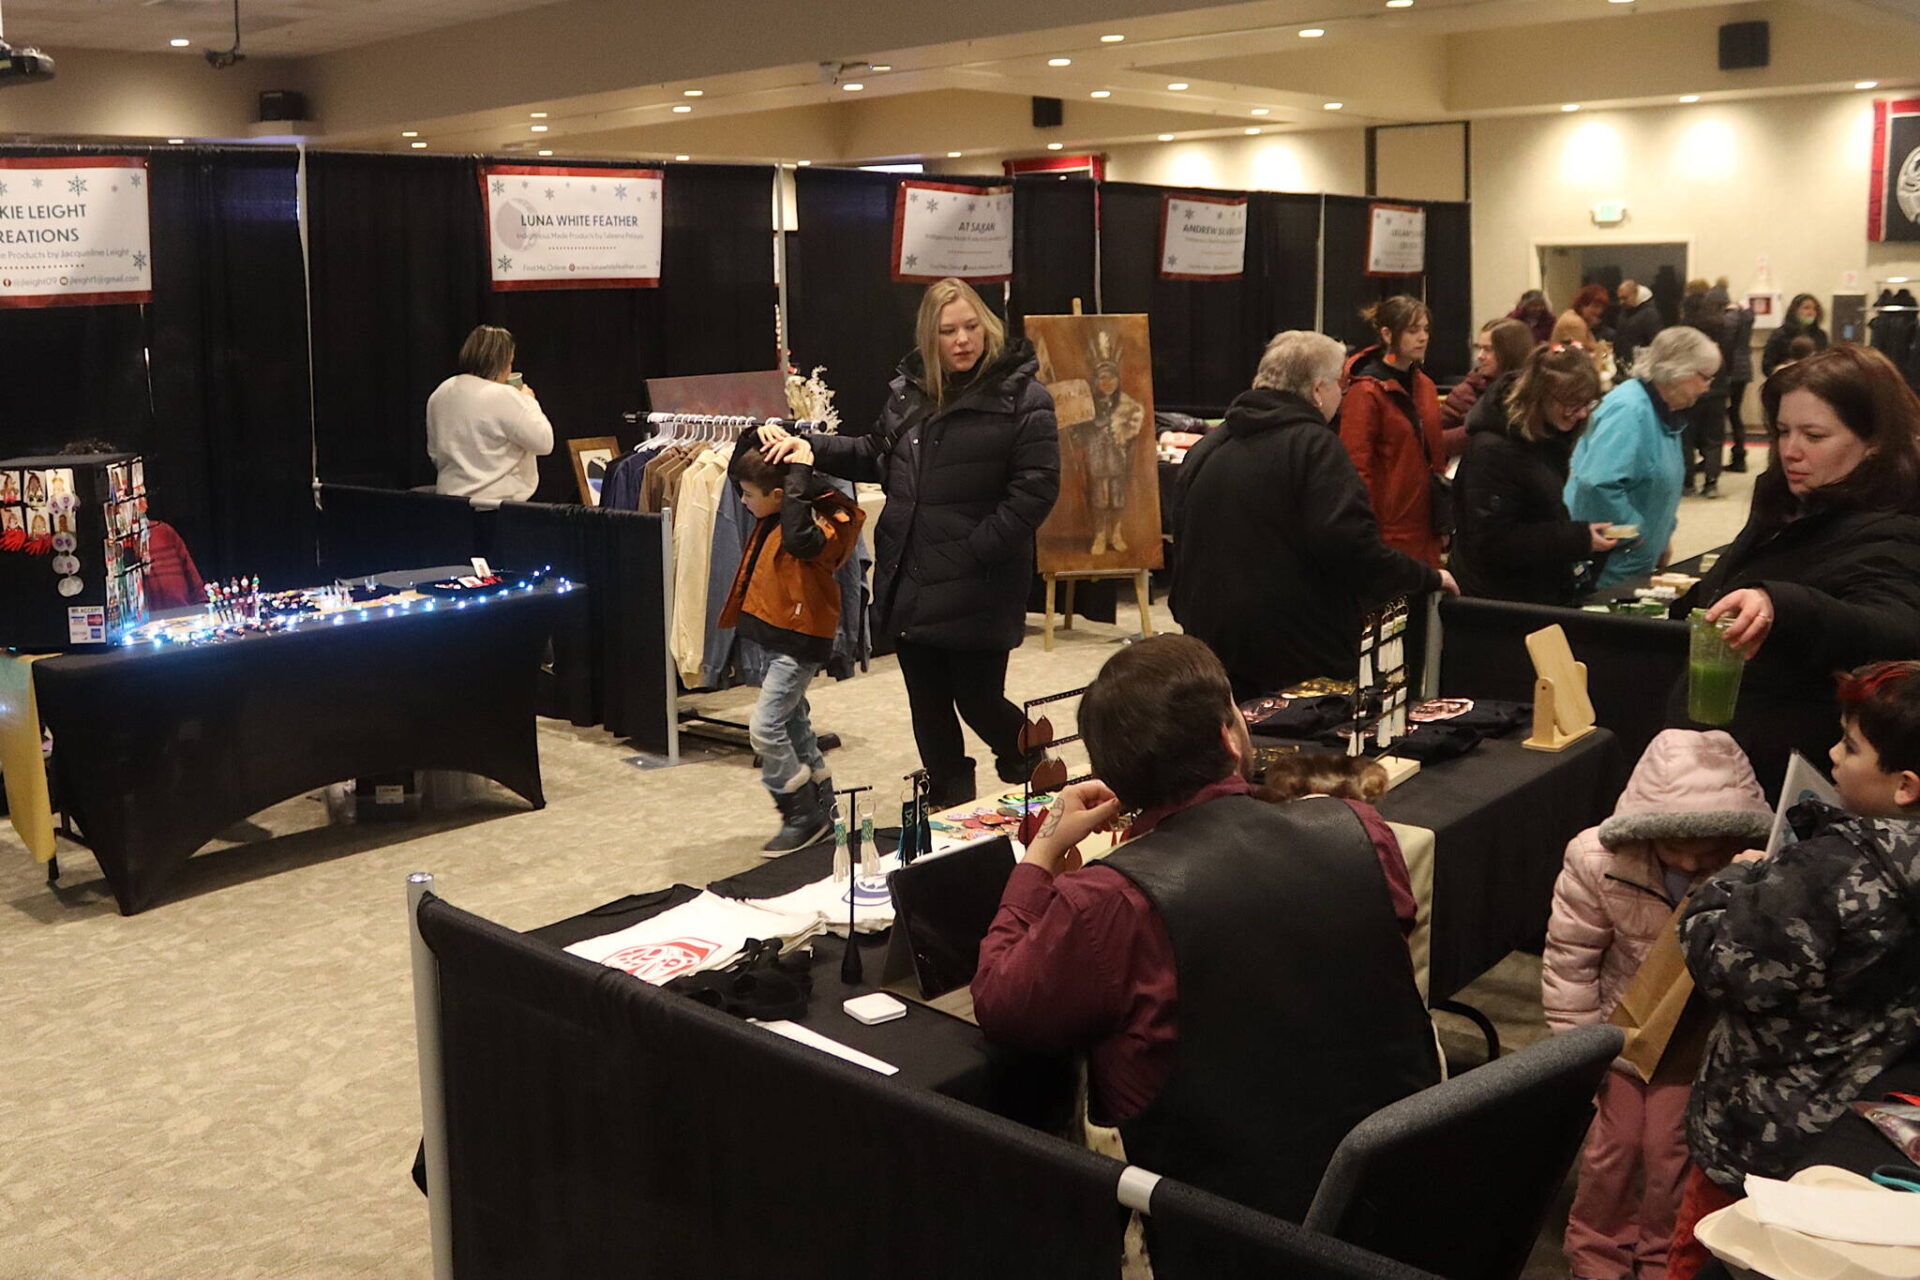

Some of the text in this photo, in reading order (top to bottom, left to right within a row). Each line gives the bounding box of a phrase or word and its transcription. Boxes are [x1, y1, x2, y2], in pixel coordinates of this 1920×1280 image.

[0, 204, 87, 220] KIE LEIGHT
[521, 214, 639, 228] LUNA WHITE FEATHER
[0, 228, 80, 244] REATIONS
[1183, 224, 1217, 235] ANDREW
[8, 250, 46, 260] Products
[47, 250, 59, 260] by
[61, 248, 104, 259] Jacqueline
[106, 248, 130, 258] Leight
